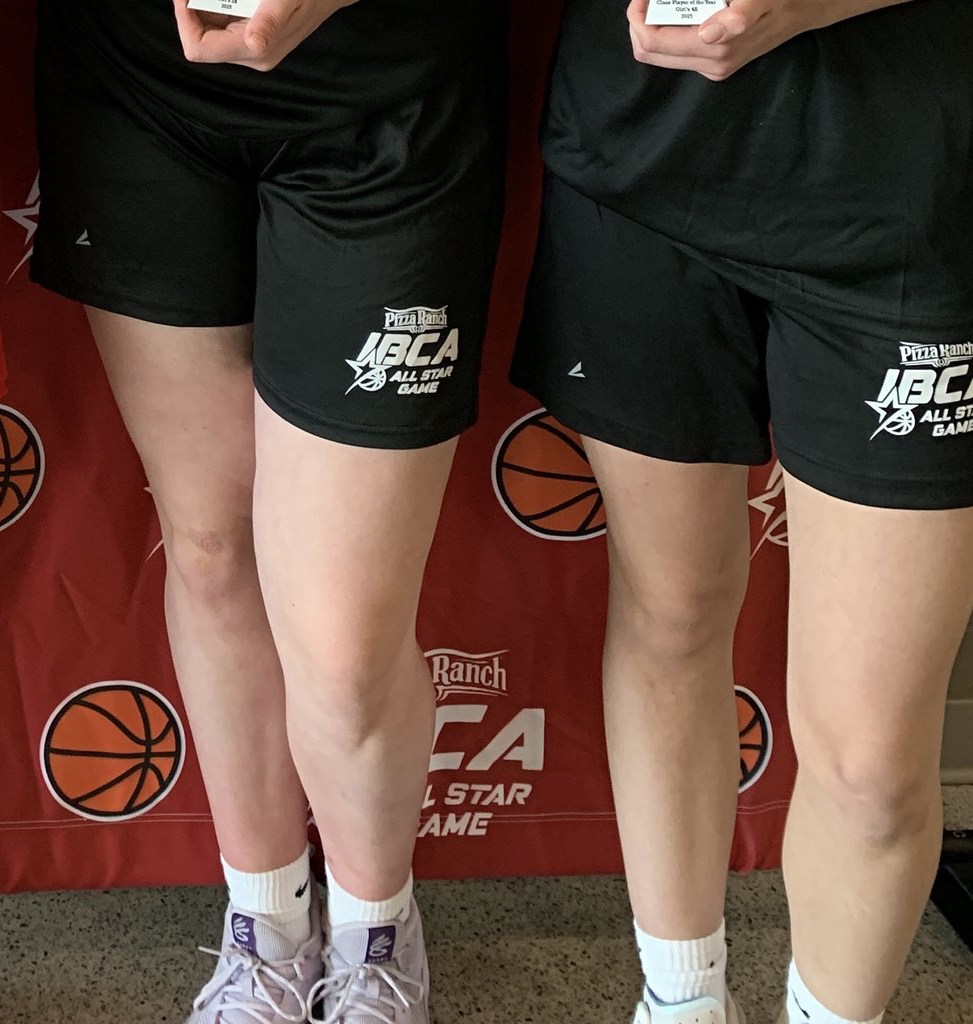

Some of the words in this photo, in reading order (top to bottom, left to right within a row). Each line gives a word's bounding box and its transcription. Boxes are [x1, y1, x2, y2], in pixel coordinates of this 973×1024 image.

[384, 311, 416, 327] Pizza
[417, 309, 448, 326] Ranch
[356, 328, 459, 367] IBCA
[899, 346, 938, 362] Pizza
[389, 370, 417, 382] ALL
[420, 365, 454, 381] STAR
[397, 381, 440, 395] GAME
[919, 409, 951, 423] ALL
[432, 655, 507, 691] Ranch
[428, 704, 545, 773] CA
[444, 782, 532, 806] STAR
[417, 812, 493, 837] AME
